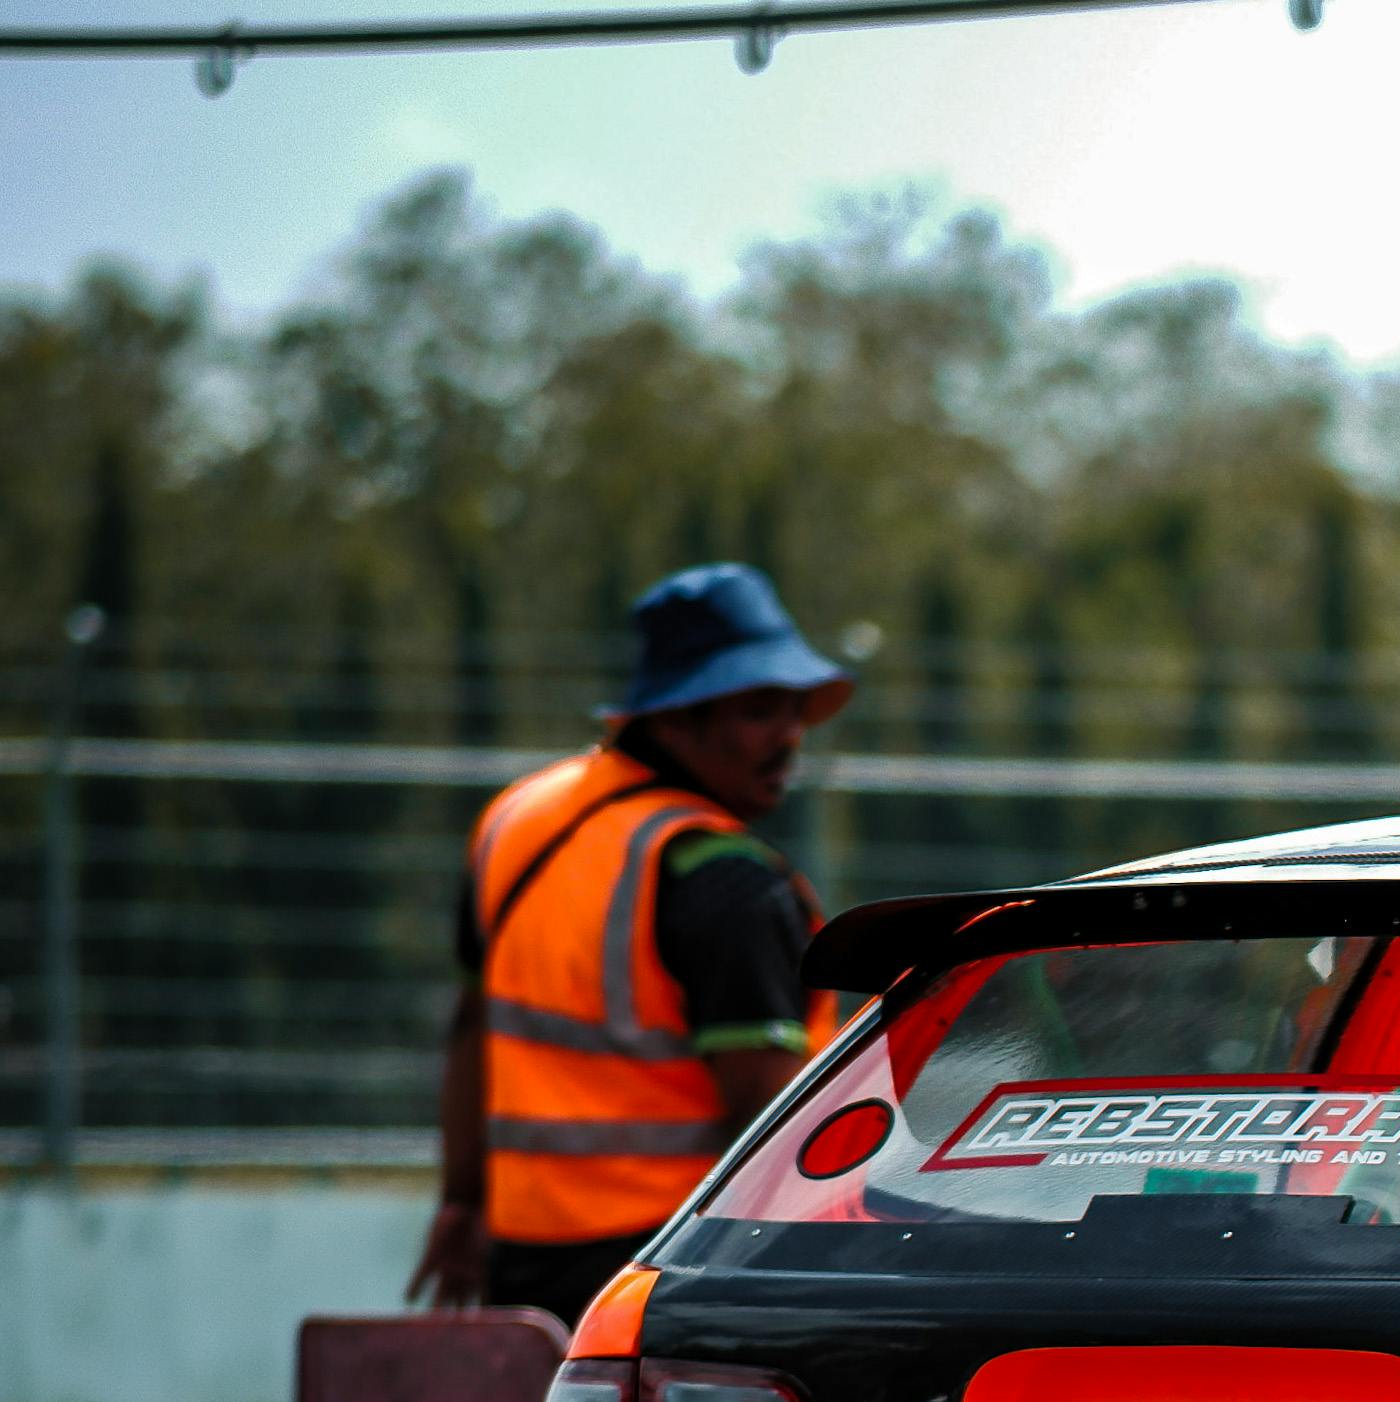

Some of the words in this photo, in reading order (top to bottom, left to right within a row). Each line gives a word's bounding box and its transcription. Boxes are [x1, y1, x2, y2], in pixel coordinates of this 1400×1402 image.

[1050, 1150, 1208, 1166] AUTOMOTIVE
[1218, 1149, 1324, 1164] STYLING
[1329, 1150, 1387, 1165] AND
